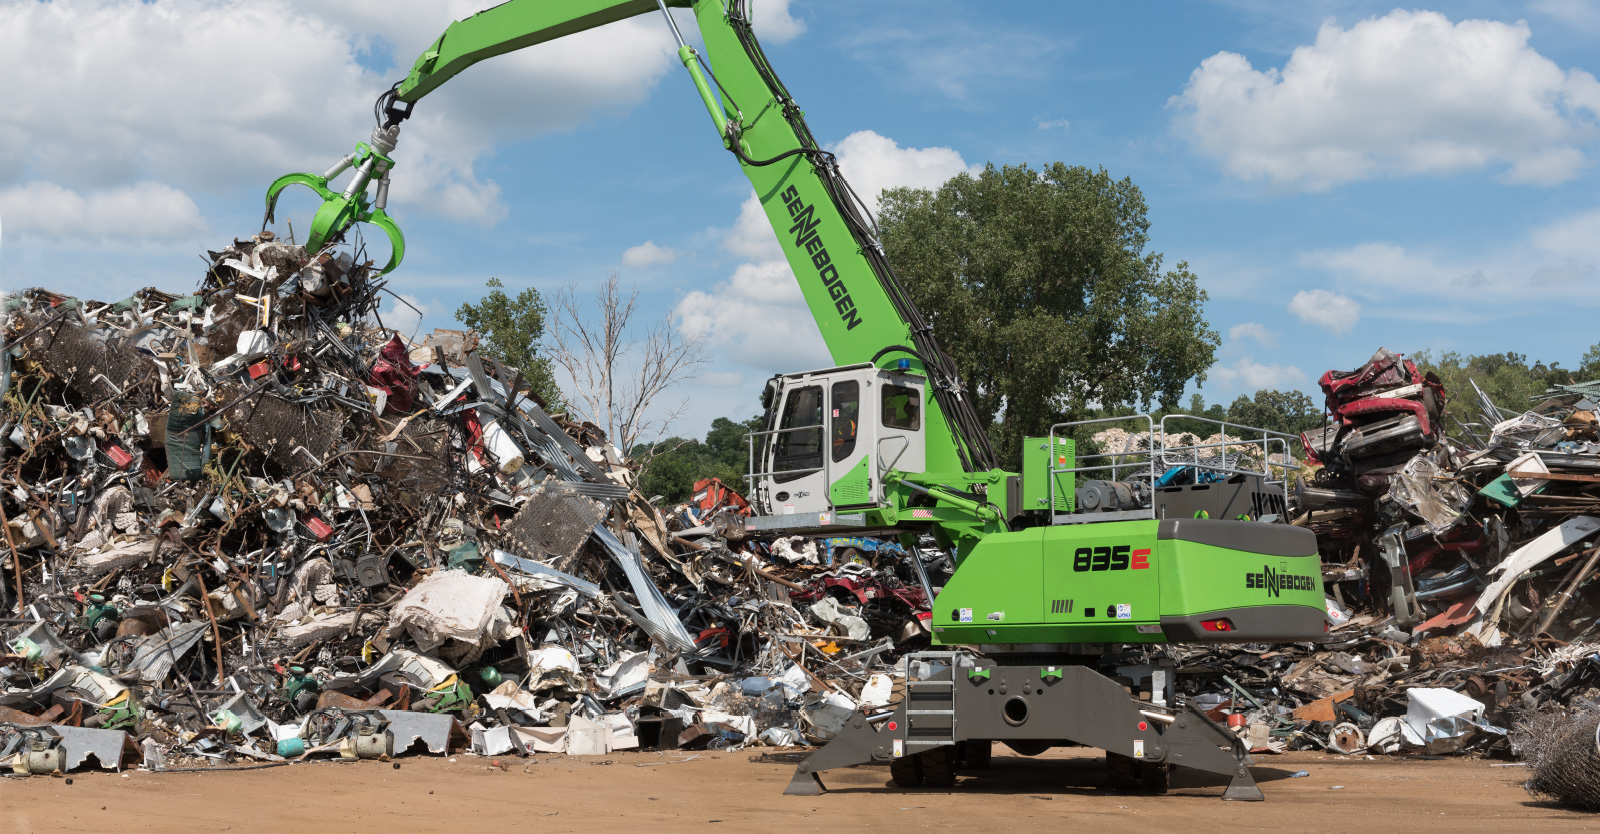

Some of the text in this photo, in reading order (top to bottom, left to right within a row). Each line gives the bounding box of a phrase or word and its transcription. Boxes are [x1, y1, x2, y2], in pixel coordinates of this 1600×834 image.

[780, 184, 863, 331] SENNEBOGEN
[1073, 545, 1151, 572] 835E
[1246, 565, 1316, 598] SENNEBOGEN
